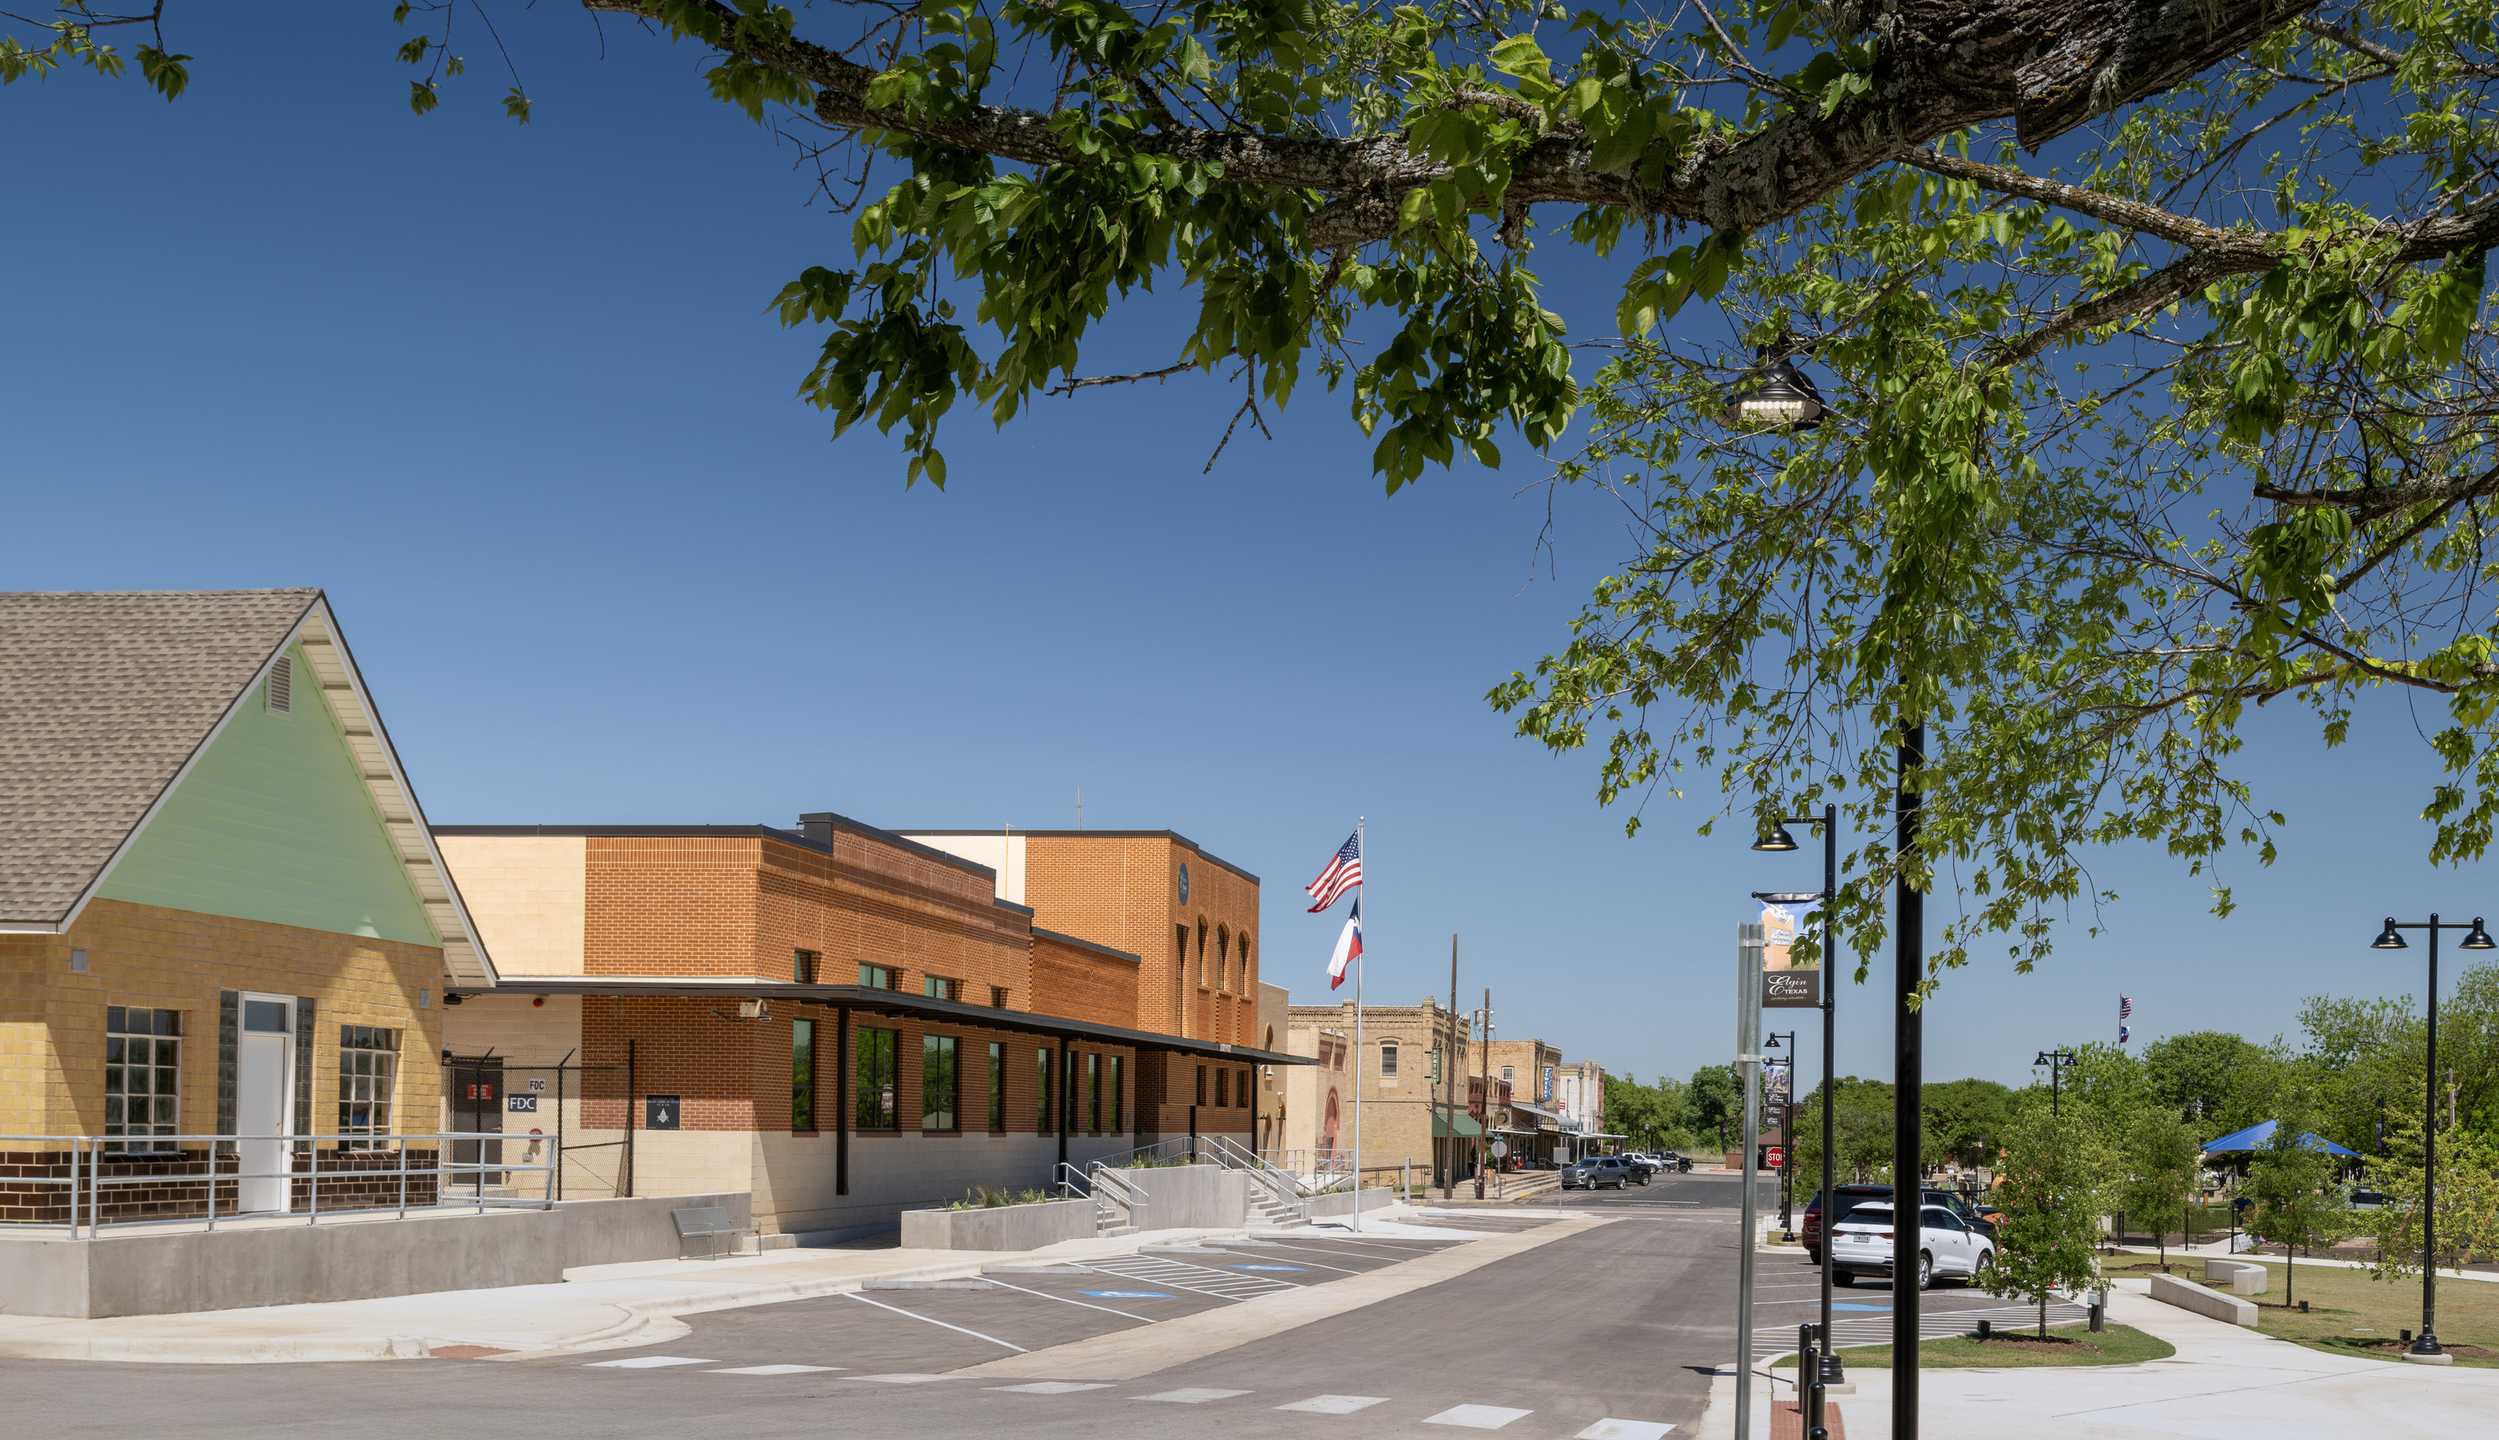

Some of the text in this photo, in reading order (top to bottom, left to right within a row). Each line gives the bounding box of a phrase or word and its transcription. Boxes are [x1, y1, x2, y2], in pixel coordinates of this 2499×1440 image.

[1768, 975, 1806, 996] Elgin
[530, 1080, 545, 1090] FDC
[510, 1097, 536, 1110] FDC
